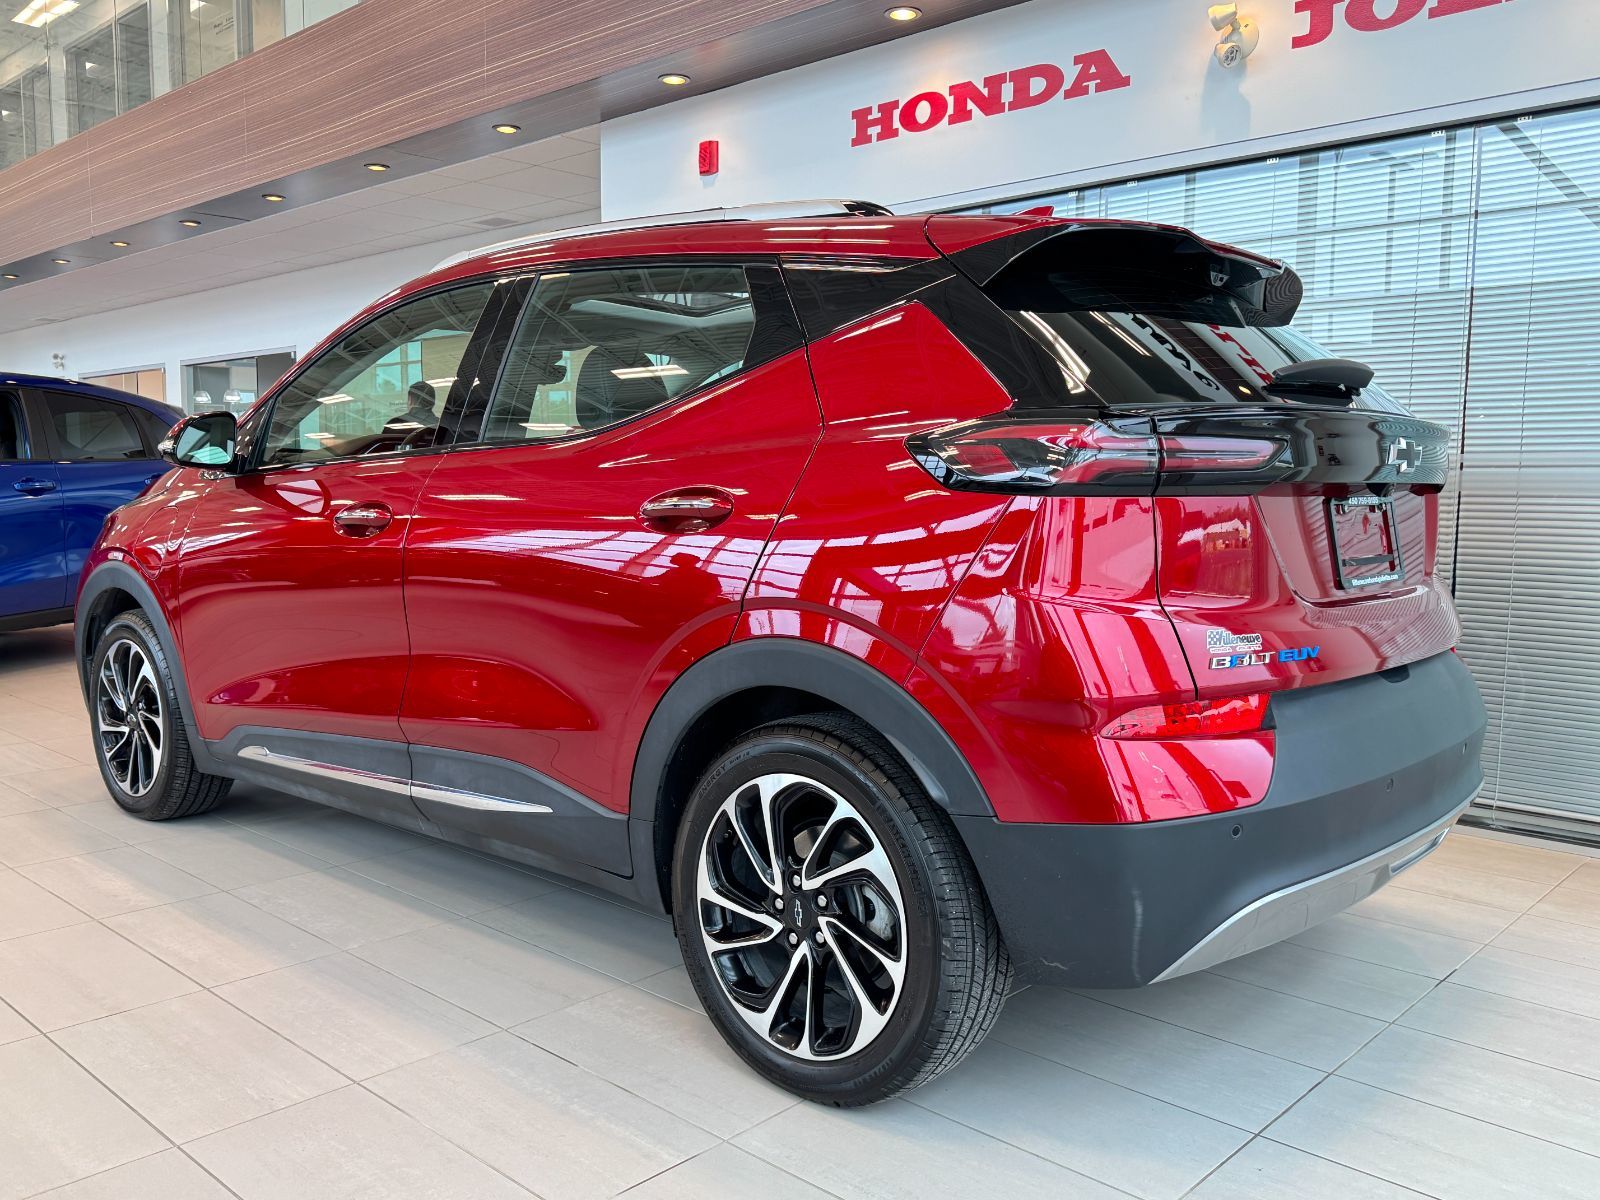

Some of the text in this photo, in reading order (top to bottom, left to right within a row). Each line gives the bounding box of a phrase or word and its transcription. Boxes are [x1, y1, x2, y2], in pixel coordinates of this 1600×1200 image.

[851, 49, 1130, 147] HONDA
[1209, 646, 1320, 669] BOLT EUV
